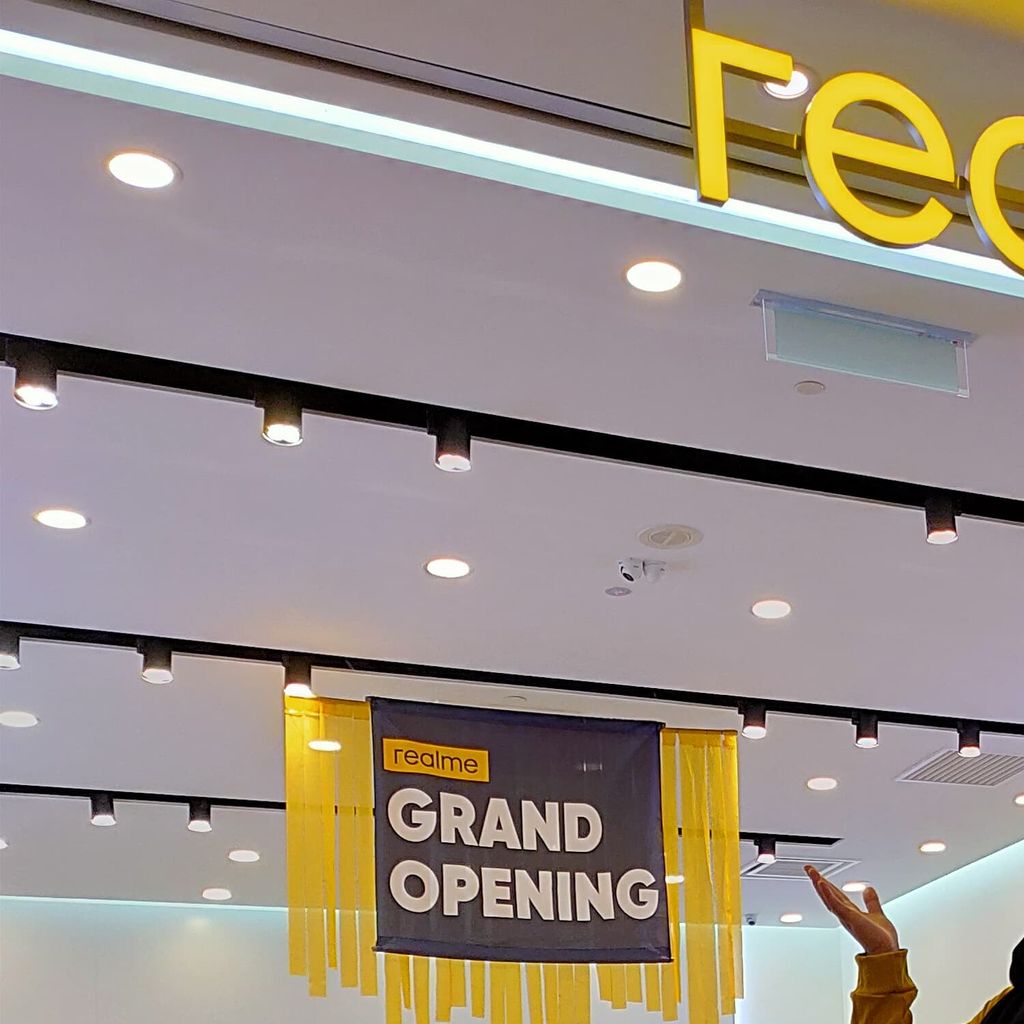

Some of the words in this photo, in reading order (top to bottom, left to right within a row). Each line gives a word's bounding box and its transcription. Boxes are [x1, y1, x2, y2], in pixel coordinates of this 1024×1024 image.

[393, 747, 479, 774] realme
[387, 787, 603, 853] GRAND
[389, 859, 659, 921] OPENING
